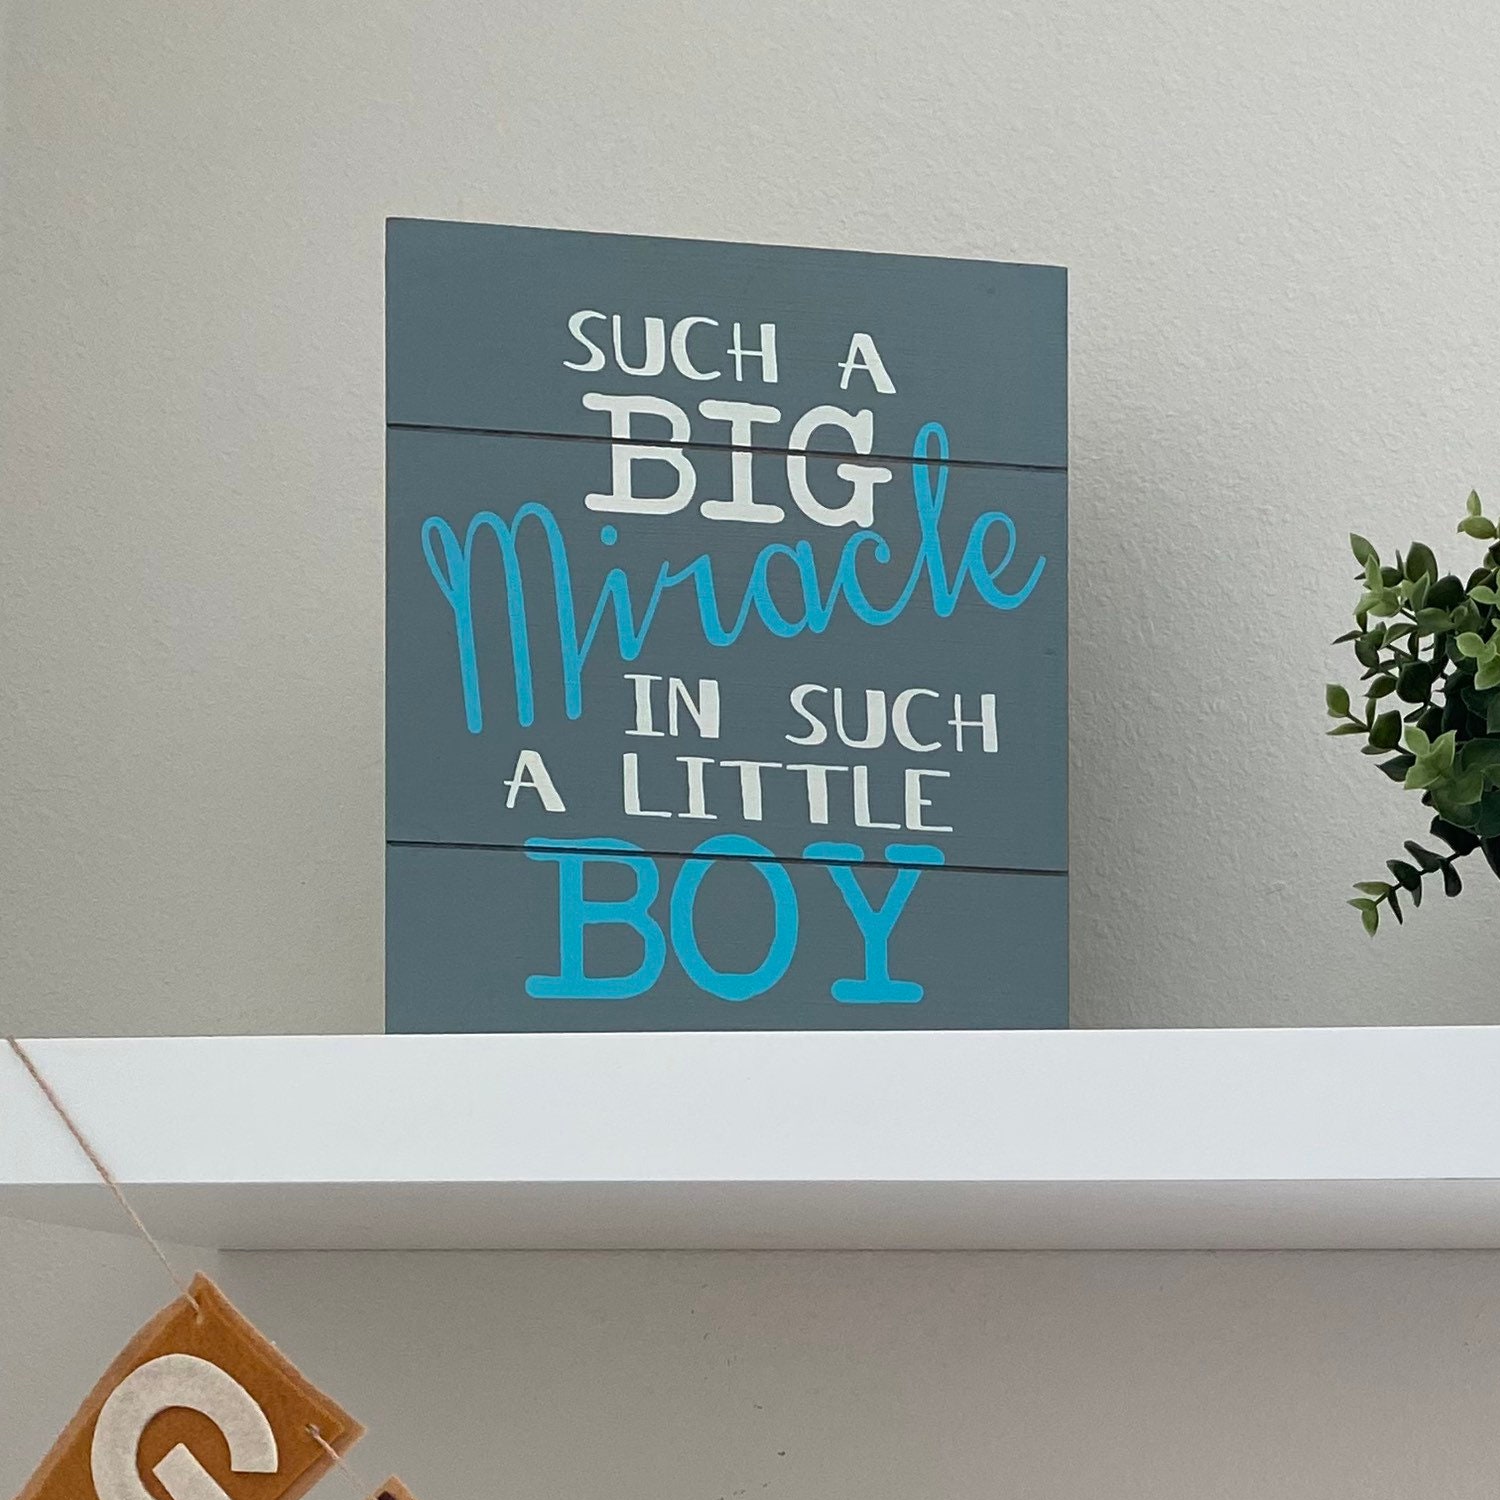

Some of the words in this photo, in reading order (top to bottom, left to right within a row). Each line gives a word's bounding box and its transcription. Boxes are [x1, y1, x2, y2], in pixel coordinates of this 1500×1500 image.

[563, 310, 779, 383] SUCH
[838, 333, 896, 394] A
[581, 392, 893, 528] BIG
[421, 422, 1047, 733] Miracle
[623, 674, 721, 738] IN
[786, 684, 1000, 753] SUCH
[503, 749, 566, 812] A
[623, 752, 954, 832] LITTLE
[524, 833, 944, 1003] BOY
